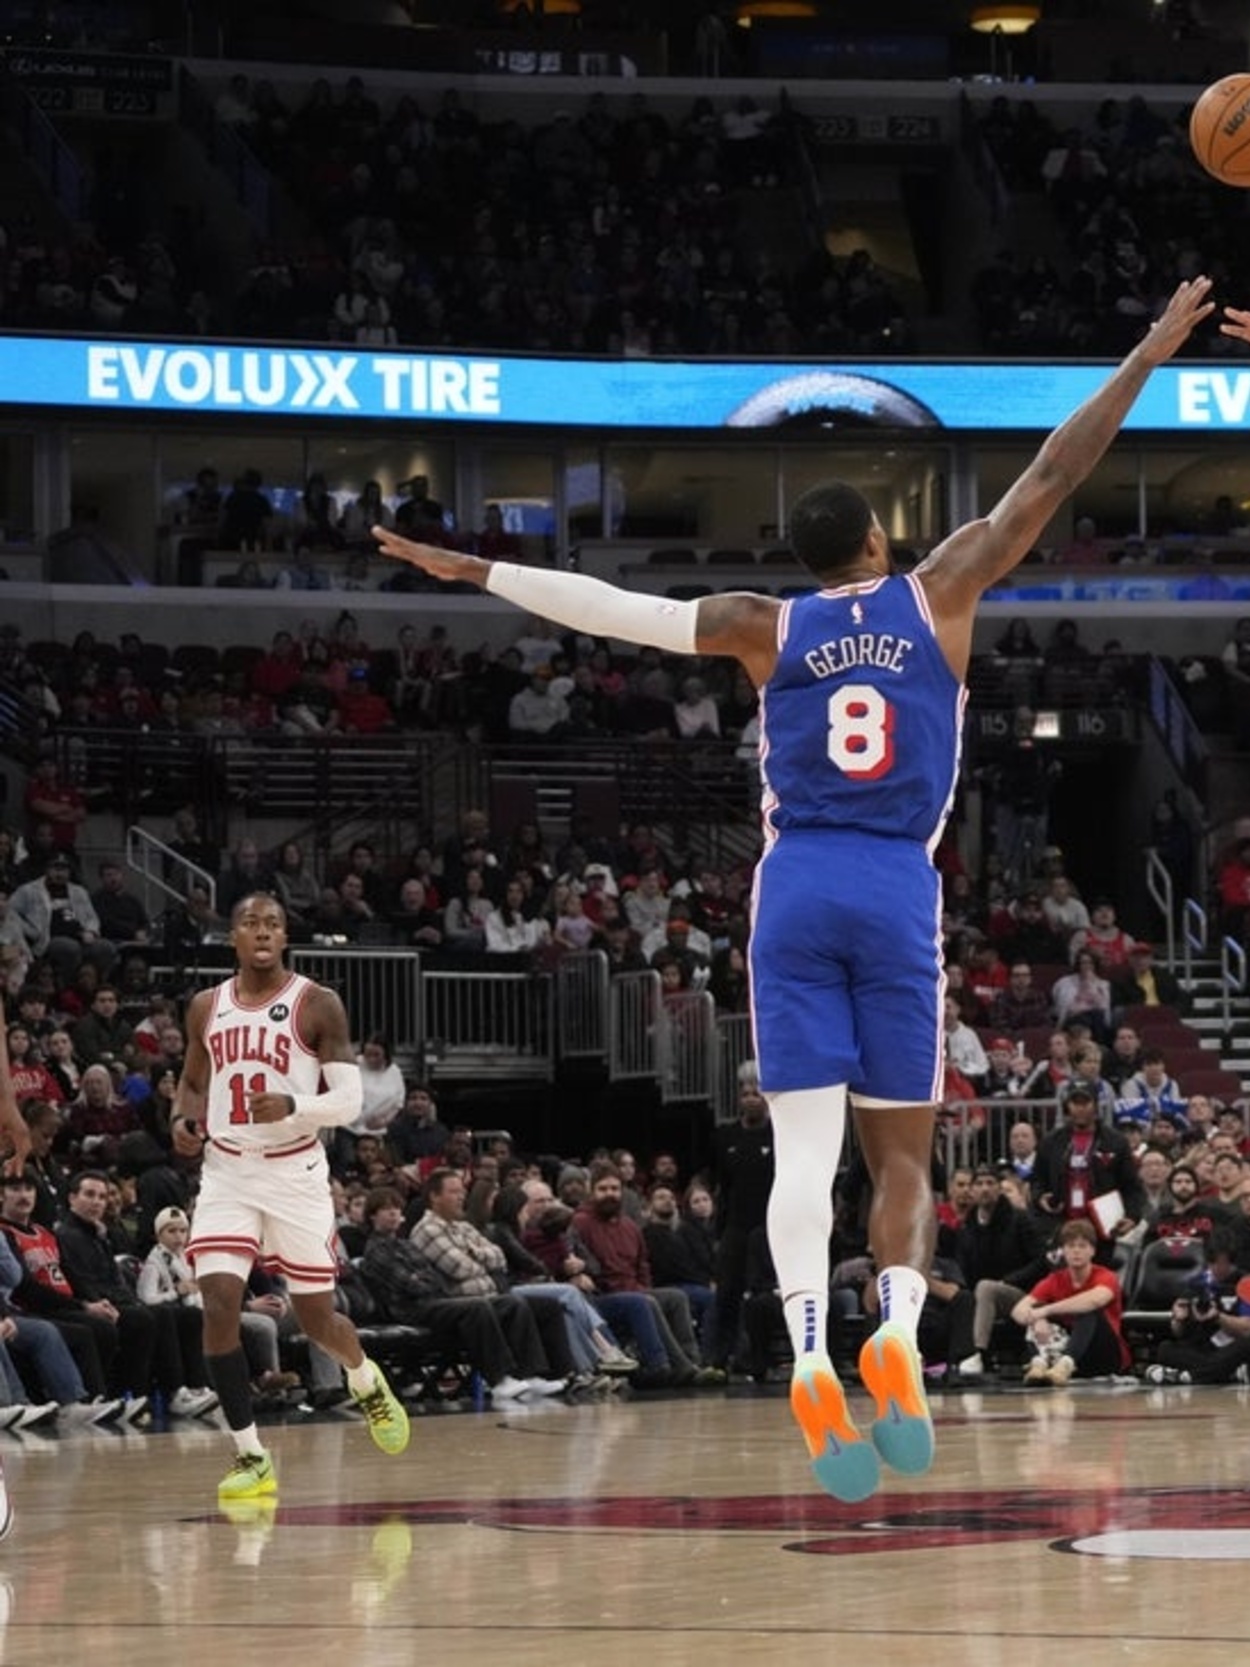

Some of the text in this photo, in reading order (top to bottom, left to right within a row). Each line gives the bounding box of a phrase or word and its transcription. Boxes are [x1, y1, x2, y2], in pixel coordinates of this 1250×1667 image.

[373, 358, 500, 414] TIRE
[804, 634, 912, 678] GEORGE
[828, 685, 896, 780] 8
[980, 711, 1007, 735] 115
[1077, 710, 1106, 735] 116
[209, 1026, 291, 1075] BULLS
